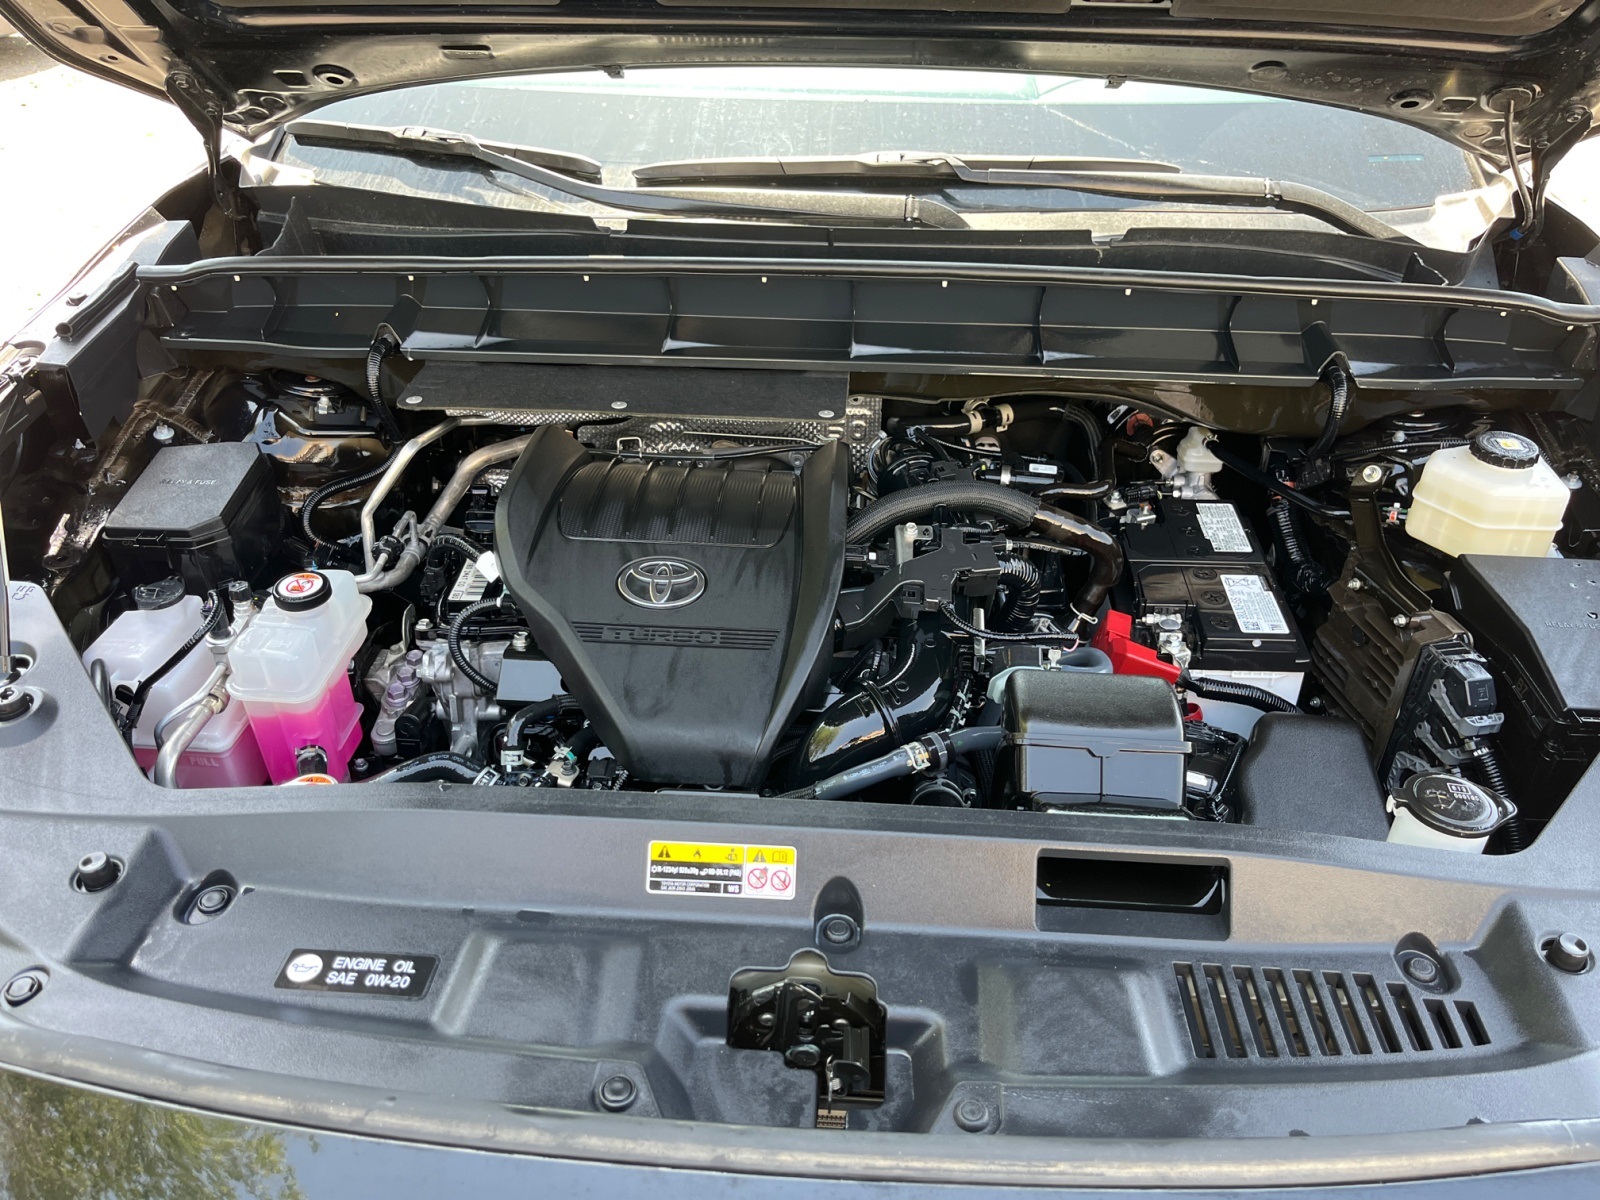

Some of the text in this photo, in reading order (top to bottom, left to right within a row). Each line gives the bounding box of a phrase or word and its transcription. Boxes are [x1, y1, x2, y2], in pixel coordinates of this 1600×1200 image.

[603, 626, 719, 644] TURBO
[728, 885, 740, 893] WS
[333, 956, 416, 974] ENGINE OIL
[325, 971, 411, 989] SAE 0W-20
